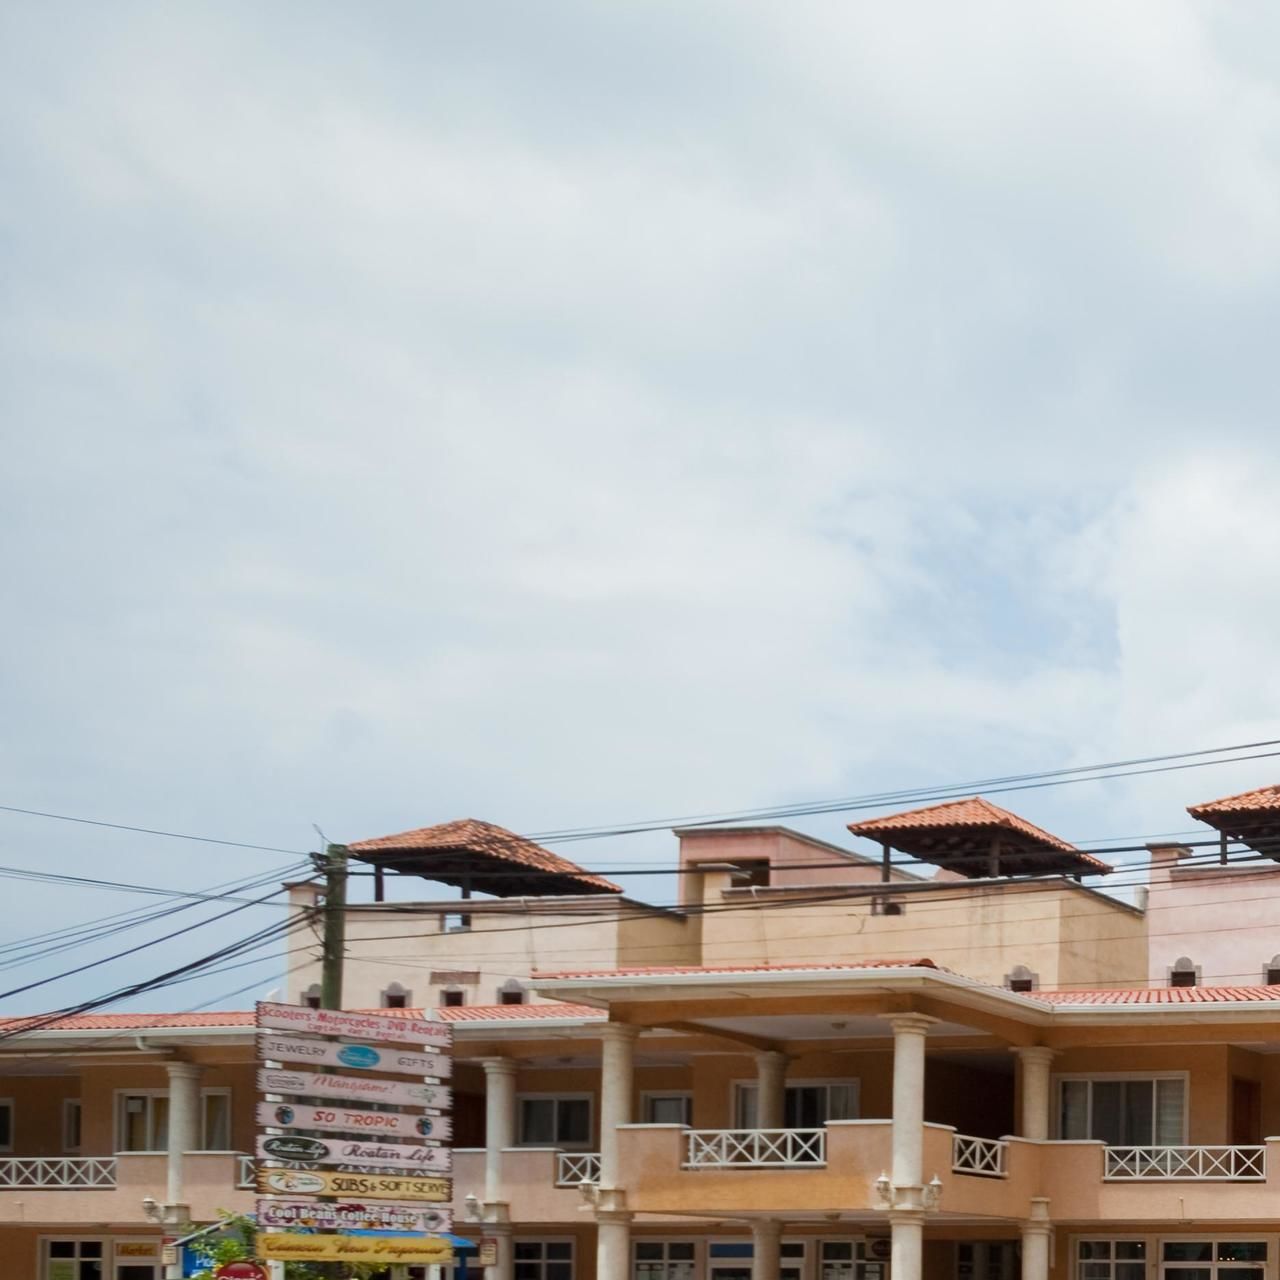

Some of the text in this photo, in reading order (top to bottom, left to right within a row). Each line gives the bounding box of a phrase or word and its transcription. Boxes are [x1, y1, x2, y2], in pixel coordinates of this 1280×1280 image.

[317, 1012, 381, 1029] Motorcycles
[268, 1041, 327, 1057] JEWELRY
[397, 1056, 434, 1070] GIFTS
[313, 1110, 399, 1128] SO TROPIC
[343, 1143, 436, 1163] Roatan Life
[330, 1177, 369, 1193] SUBS
[378, 1180, 412, 1193] SOFT
[414, 1183, 449, 1194] SERVE
[269, 1206, 418, 1224] Cool Beans Coffee House
